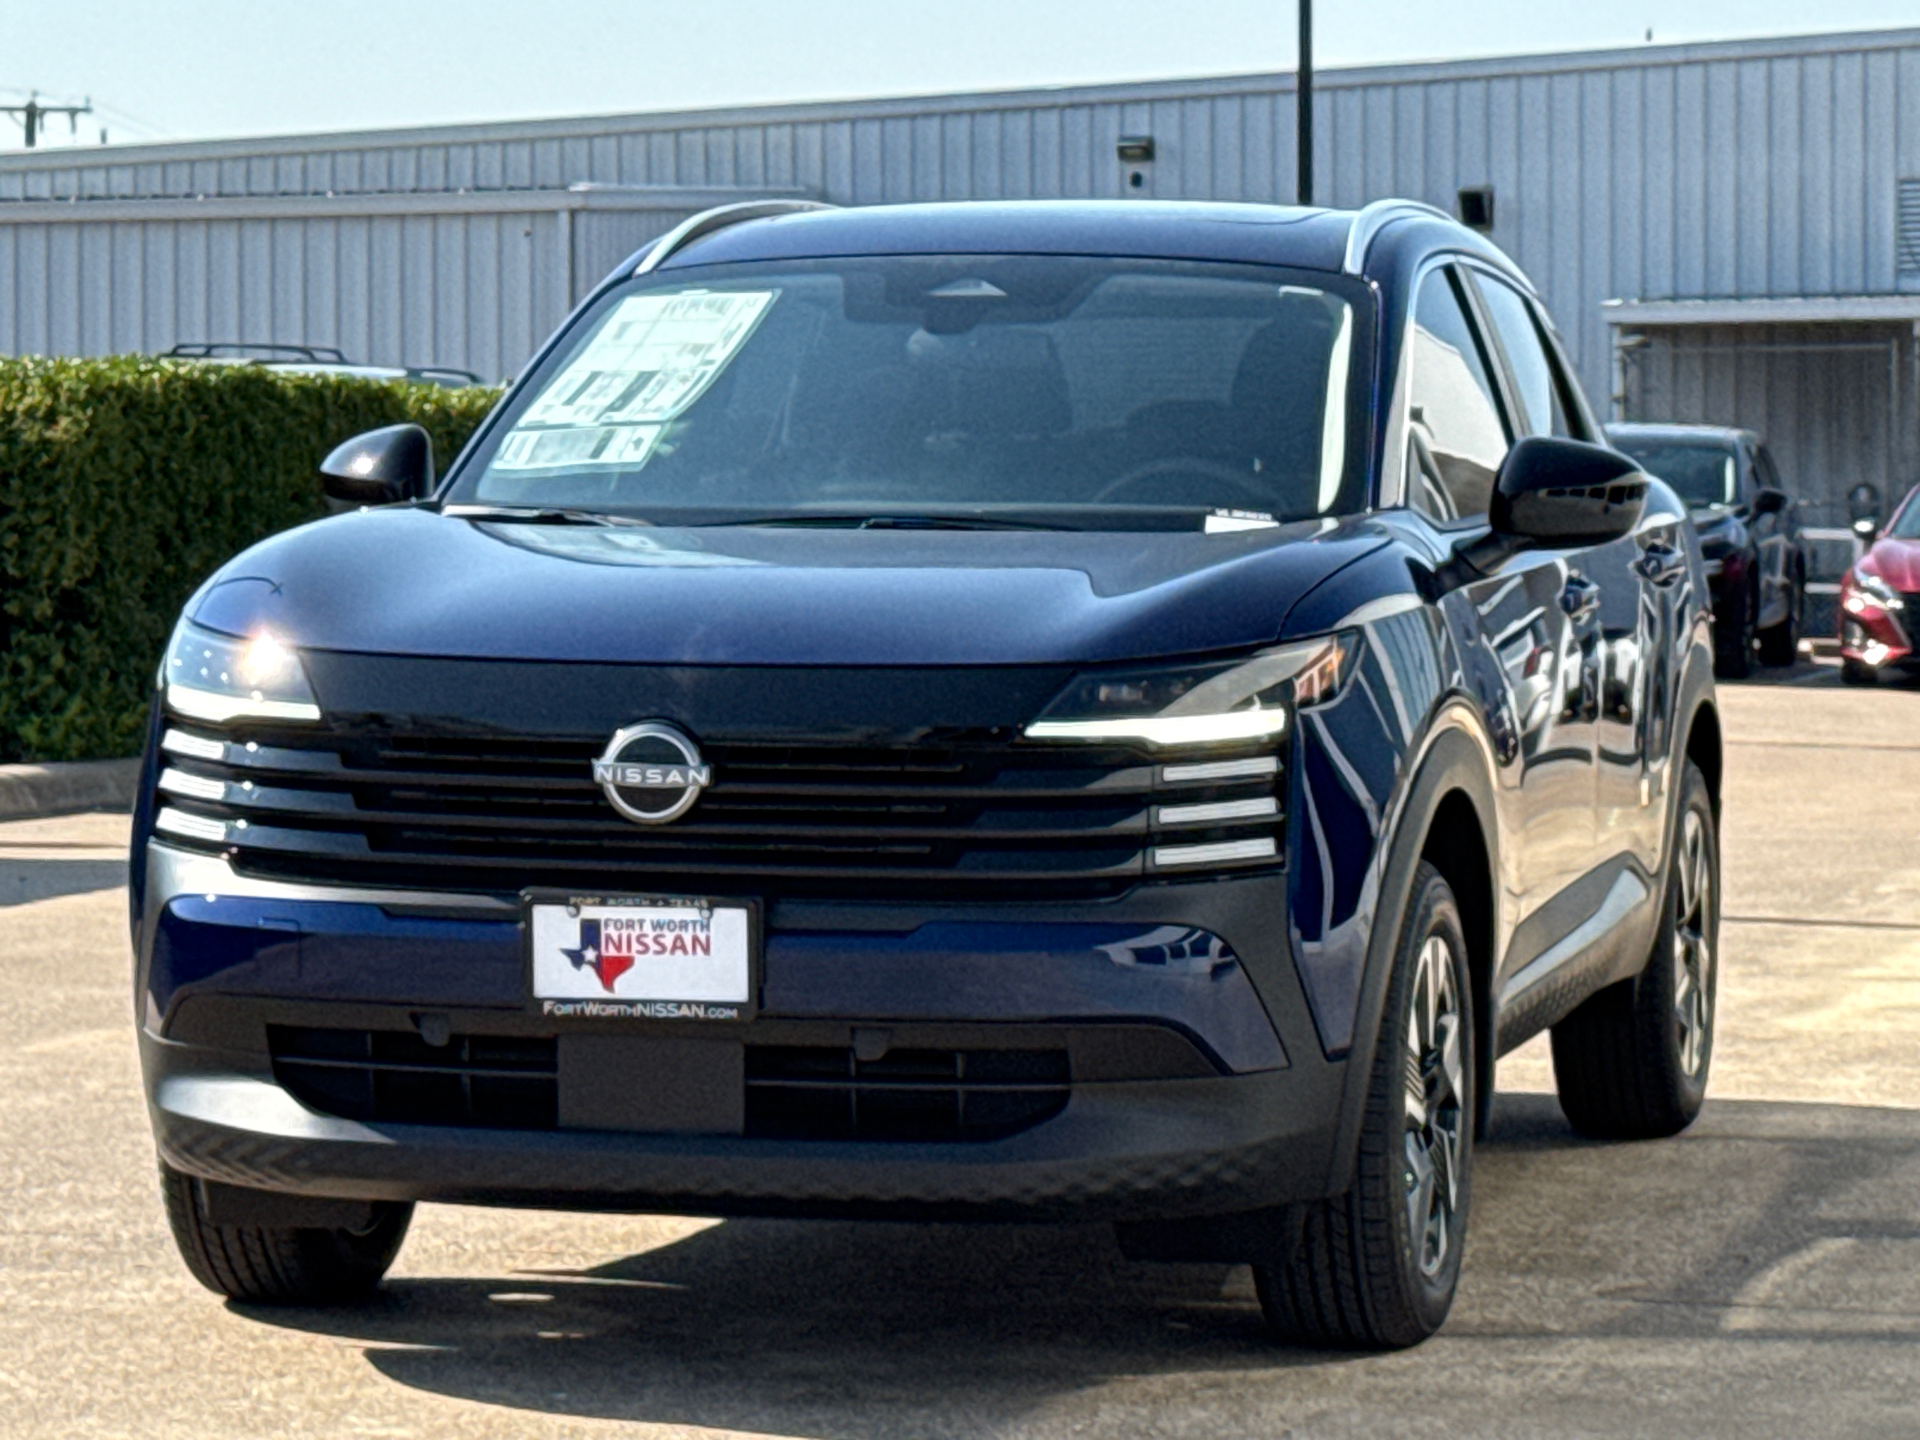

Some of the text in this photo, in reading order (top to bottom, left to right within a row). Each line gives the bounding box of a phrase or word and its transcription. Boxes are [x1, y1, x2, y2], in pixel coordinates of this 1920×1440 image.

[596, 765, 709, 786] NISSAN
[603, 918, 711, 932] FORT WORTH
[603, 933, 711, 956] NISSAN
